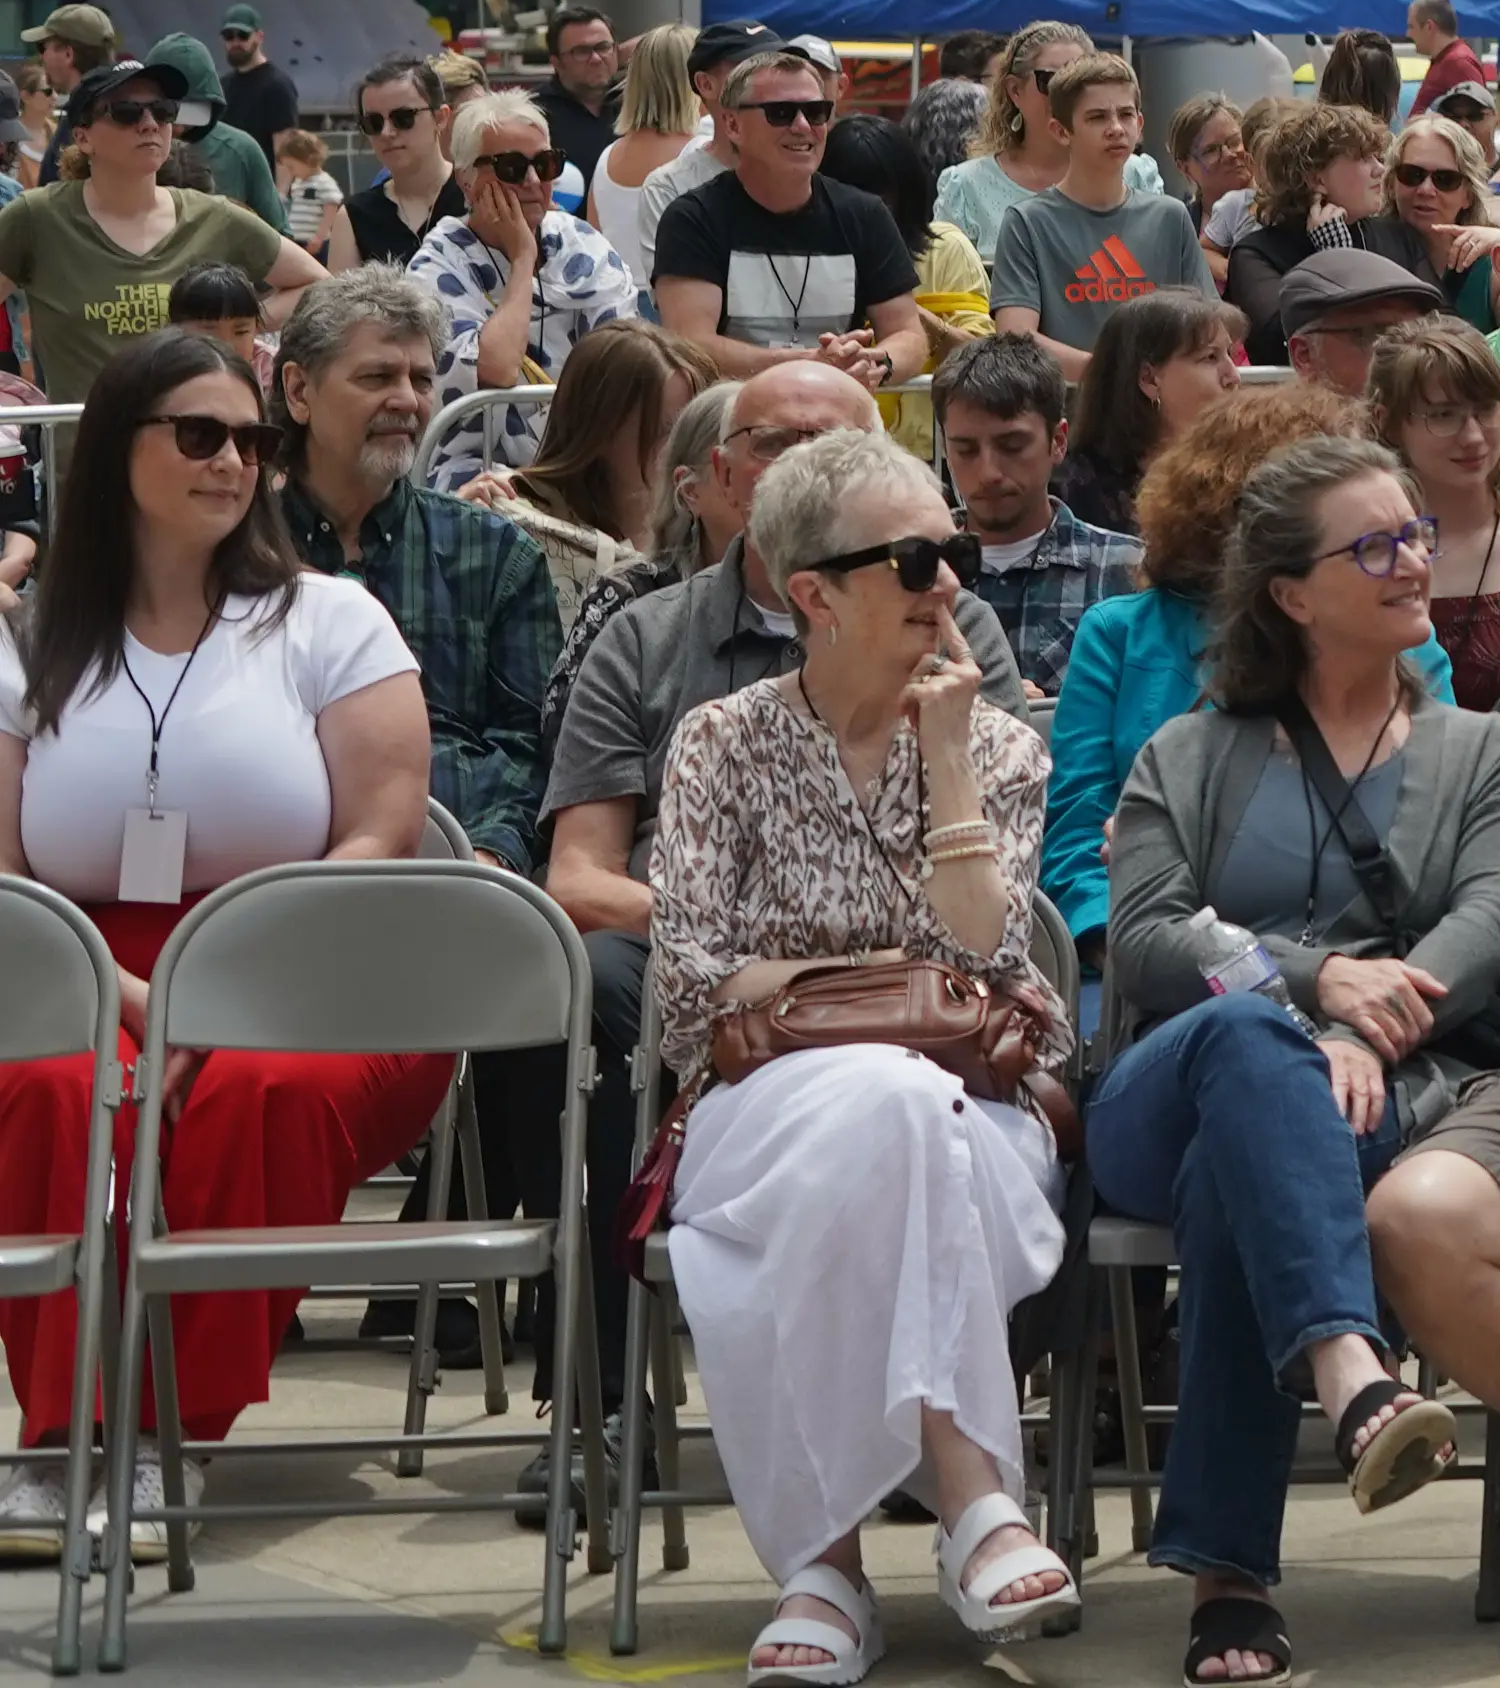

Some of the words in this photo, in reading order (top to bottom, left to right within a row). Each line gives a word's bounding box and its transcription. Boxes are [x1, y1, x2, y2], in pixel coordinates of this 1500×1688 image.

[115, 283, 158, 301] THE
[84, 300, 159, 321] NORTH
[107, 316, 160, 335] FACE
